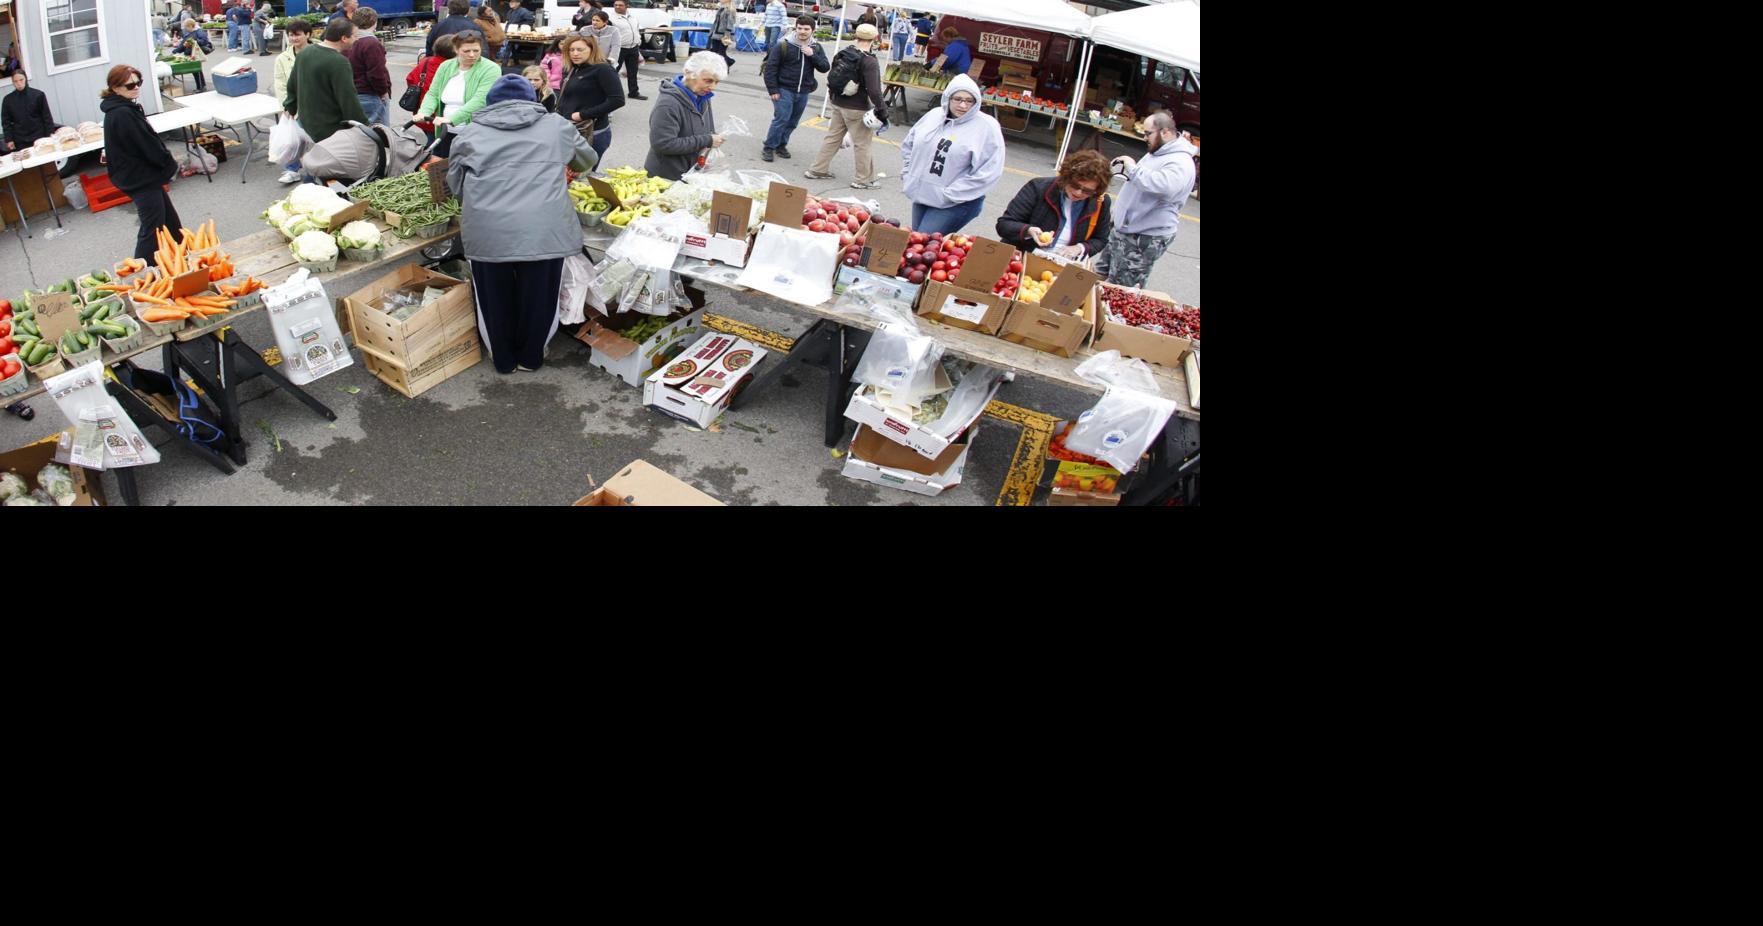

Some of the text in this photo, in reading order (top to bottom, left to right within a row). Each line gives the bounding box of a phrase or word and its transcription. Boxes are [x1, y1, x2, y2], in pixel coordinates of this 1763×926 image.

[979, 41, 998, 51] FRUITS
[982, 33, 1039, 51] SEYLER FARM
[784, 188, 794, 198] 5
[878, 247, 889, 262] 4
[983, 243, 999, 255] 5
